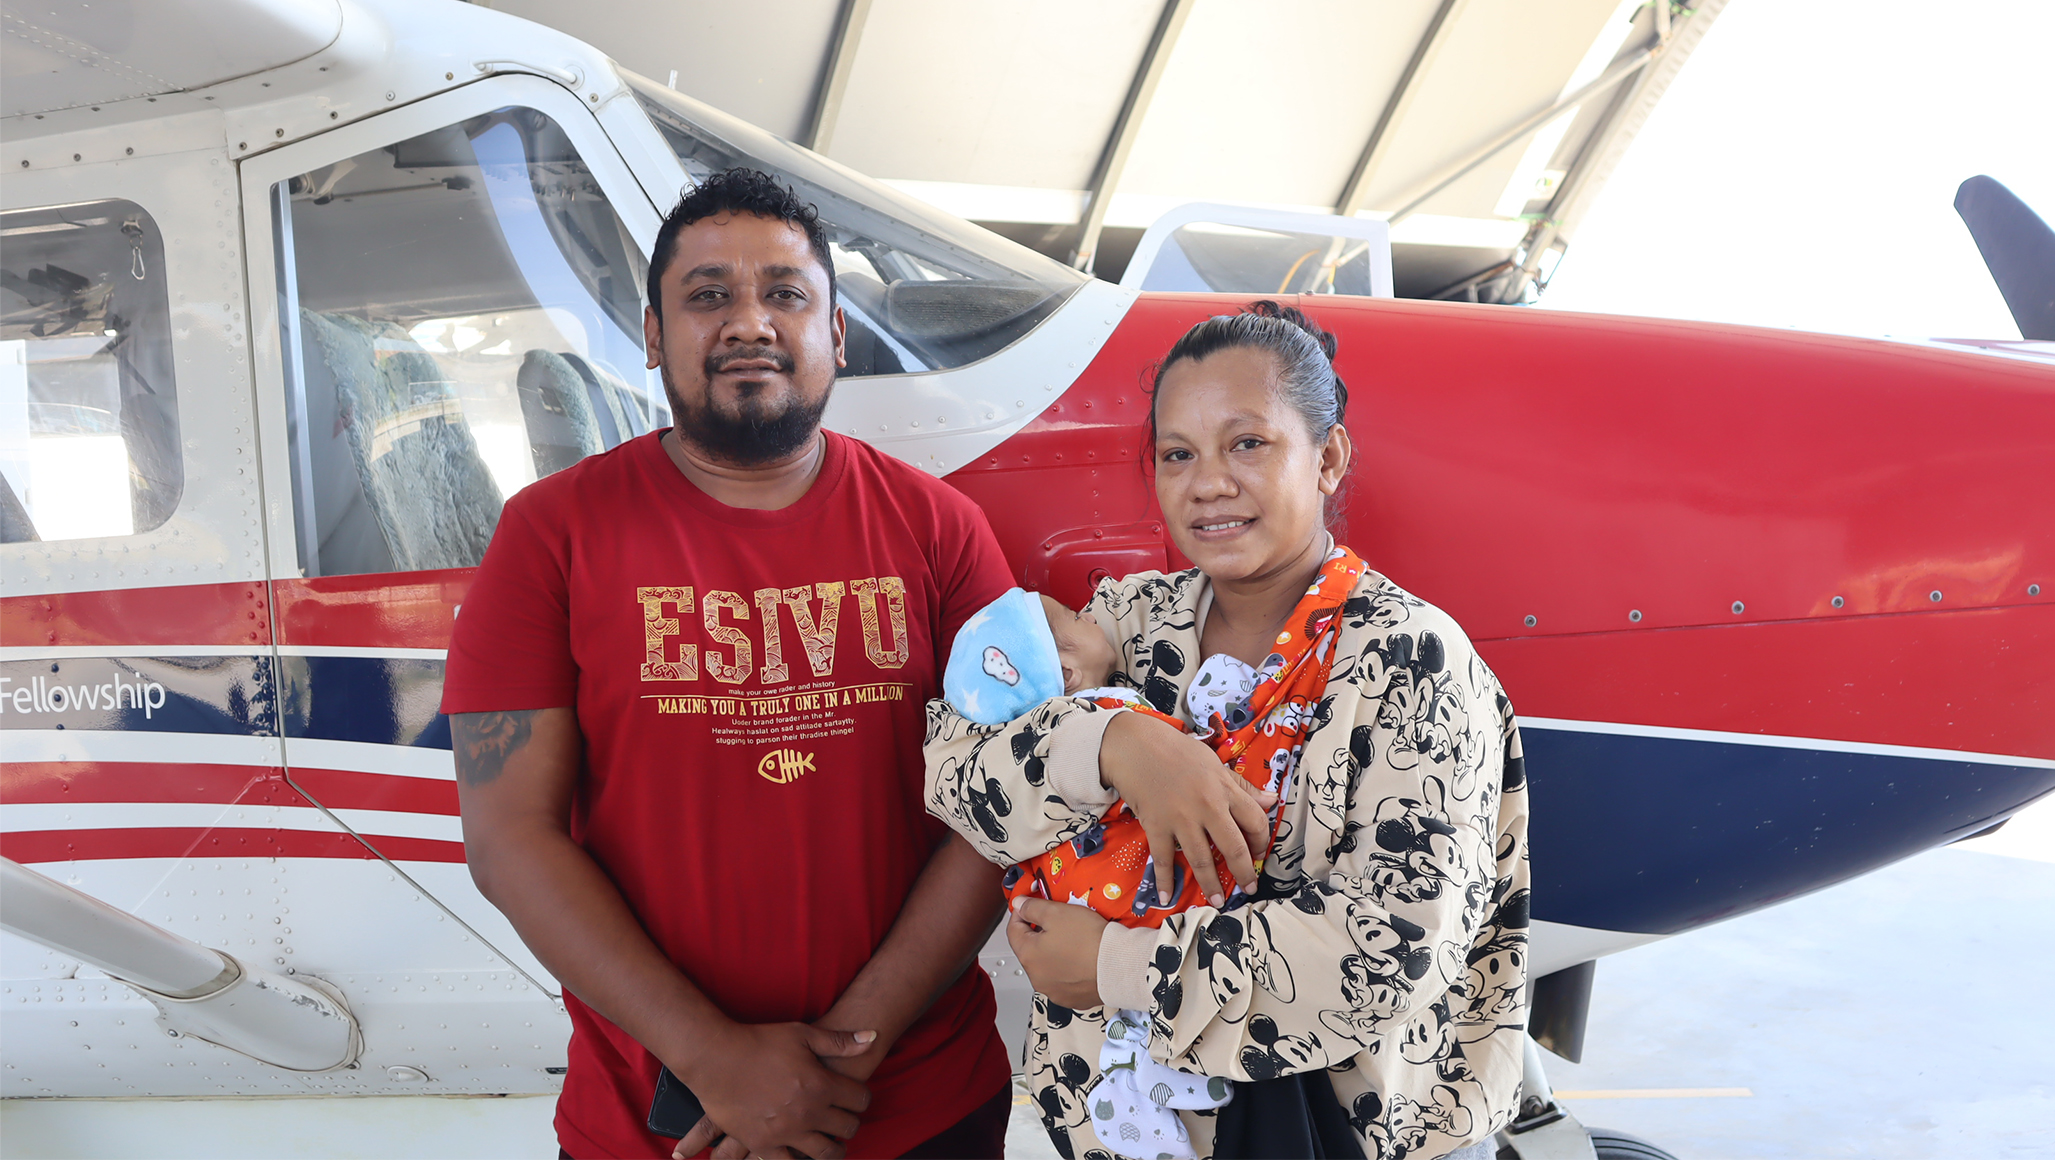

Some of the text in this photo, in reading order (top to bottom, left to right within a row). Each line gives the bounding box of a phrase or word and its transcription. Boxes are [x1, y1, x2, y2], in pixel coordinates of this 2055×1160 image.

[637, 576, 910, 684] ESIVU
[0, 672, 166, 719] Fellowship
[746, 689, 762, 697] your
[812, 680, 836, 689] history
[657, 698, 707, 714] MAKING
[710, 699, 735, 715] YOU
[739, 701, 747, 716] A
[750, 697, 790, 716] TRULY
[795, 693, 820, 711] ONE
[824, 692, 838, 708] IN
[842, 690, 852, 705] A
[753, 717, 774, 726] brand
[811, 712, 823, 720] the
[755, 736, 781, 746] parson
[782, 733, 798, 742] their
